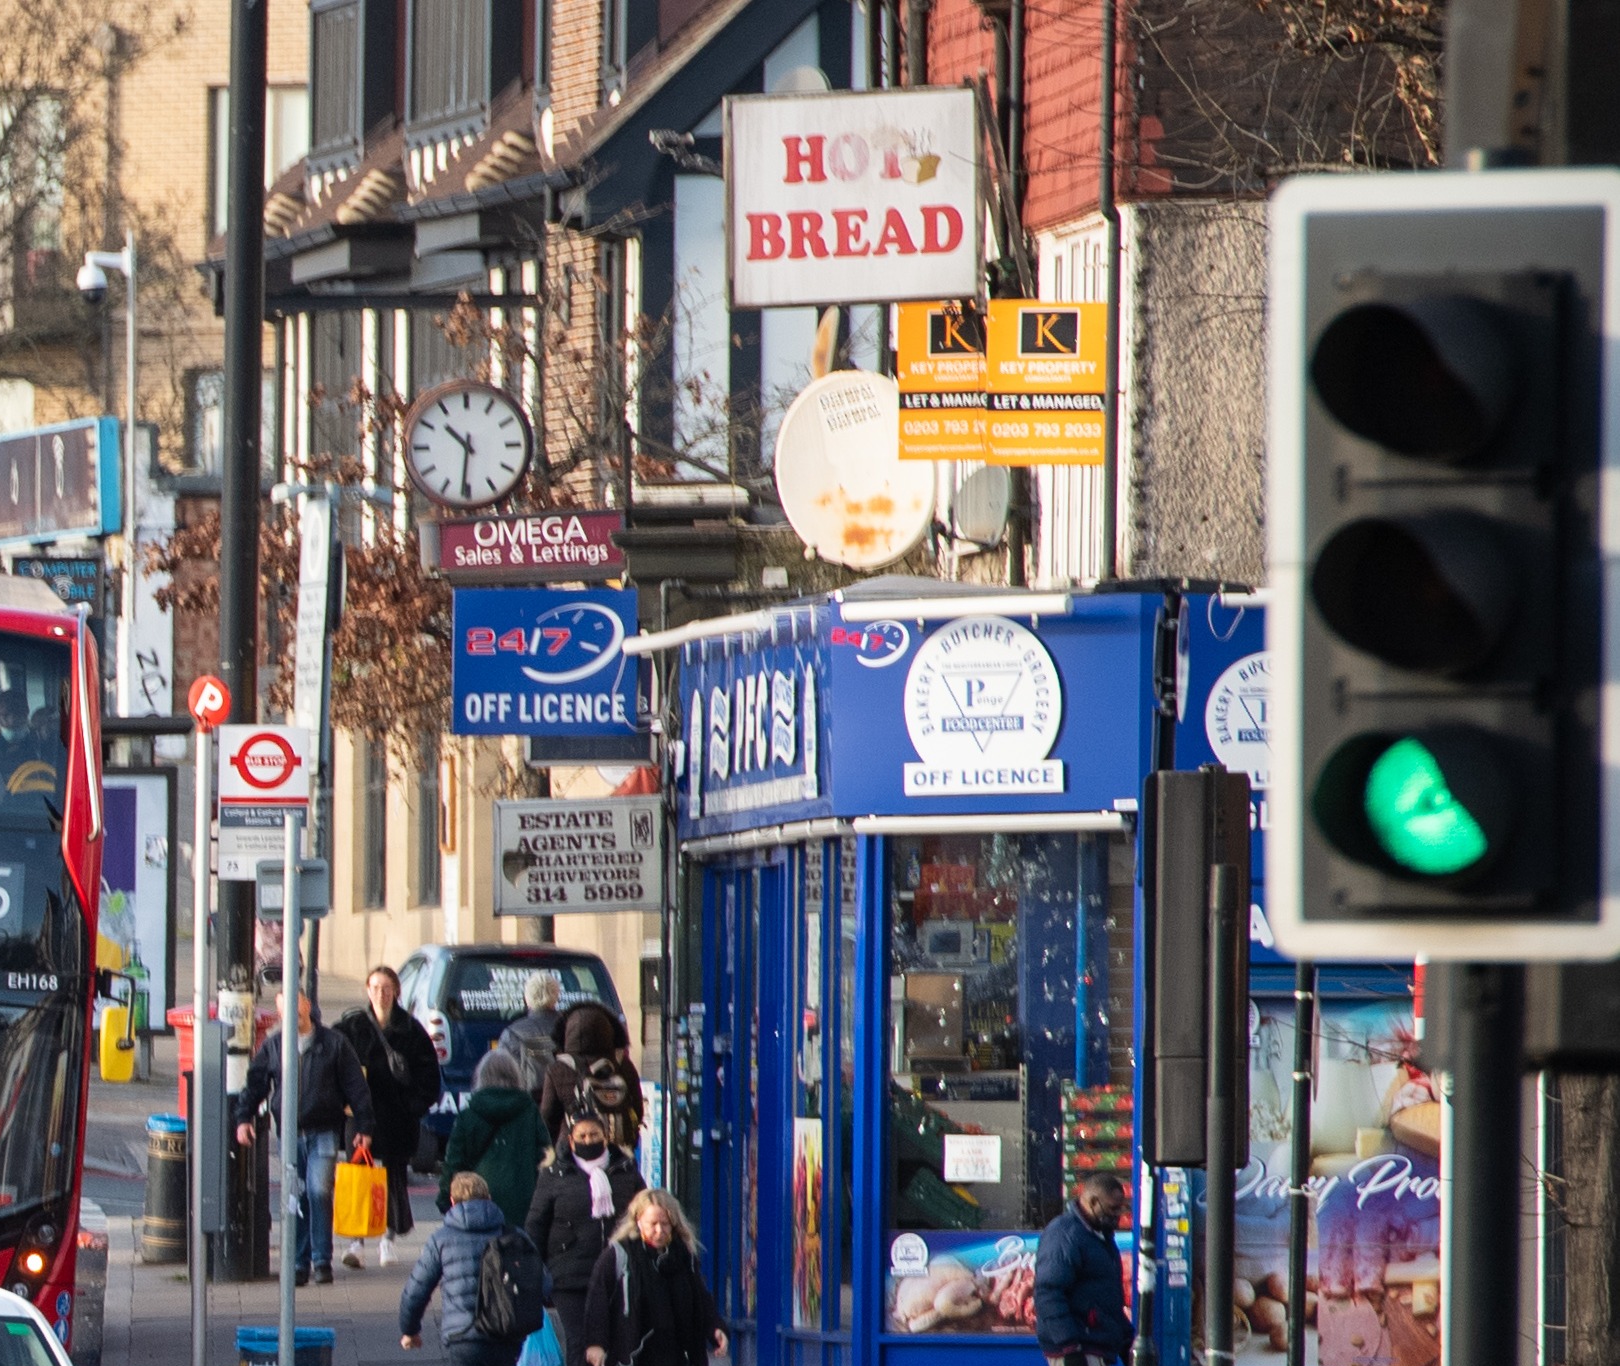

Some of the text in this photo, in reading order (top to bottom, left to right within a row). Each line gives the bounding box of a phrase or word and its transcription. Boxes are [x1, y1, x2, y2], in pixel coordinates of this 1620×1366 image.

[782, 128, 902, 183] HOT
[745, 204, 964, 261] BREAD
[1036, 313, 1071, 353] K
[911, 361, 987, 375] KEY PROPER
[1000, 361, 1097, 374] KEY PROPERTY
[905, 392, 987, 409] LET & MANAG
[994, 395, 1101, 411] LET & MANAGED
[904, 420, 939, 436] 0203
[992, 423, 1029, 438] 0203
[1033, 423, 1060, 438] 793
[1065, 423, 1101, 438] 2033
[474, 516, 588, 547] OMEGA
[455, 542, 609, 566] Sales & Lettings
[466, 626, 572, 656] 24/7
[941, 623, 1014, 653] BUTCHER
[195, 682, 224, 717] P
[916, 662, 936, 736] BAKERY
[1023, 650, 1050, 735] GROCERY
[465, 692, 627, 724] OFF LICENCE
[1219, 687, 1234, 746] BAKERY
[914, 768, 1055, 786] OFF LICENCE
[518, 810, 613, 830] ESTATE
[517, 833, 616, 852] AGENTS
[528, 852, 644, 868] HARTERED
[528, 867, 641, 884] SURVEYORS
[527, 883, 644, 903] 314 5959
[8, 972, 59, 991] EH168
